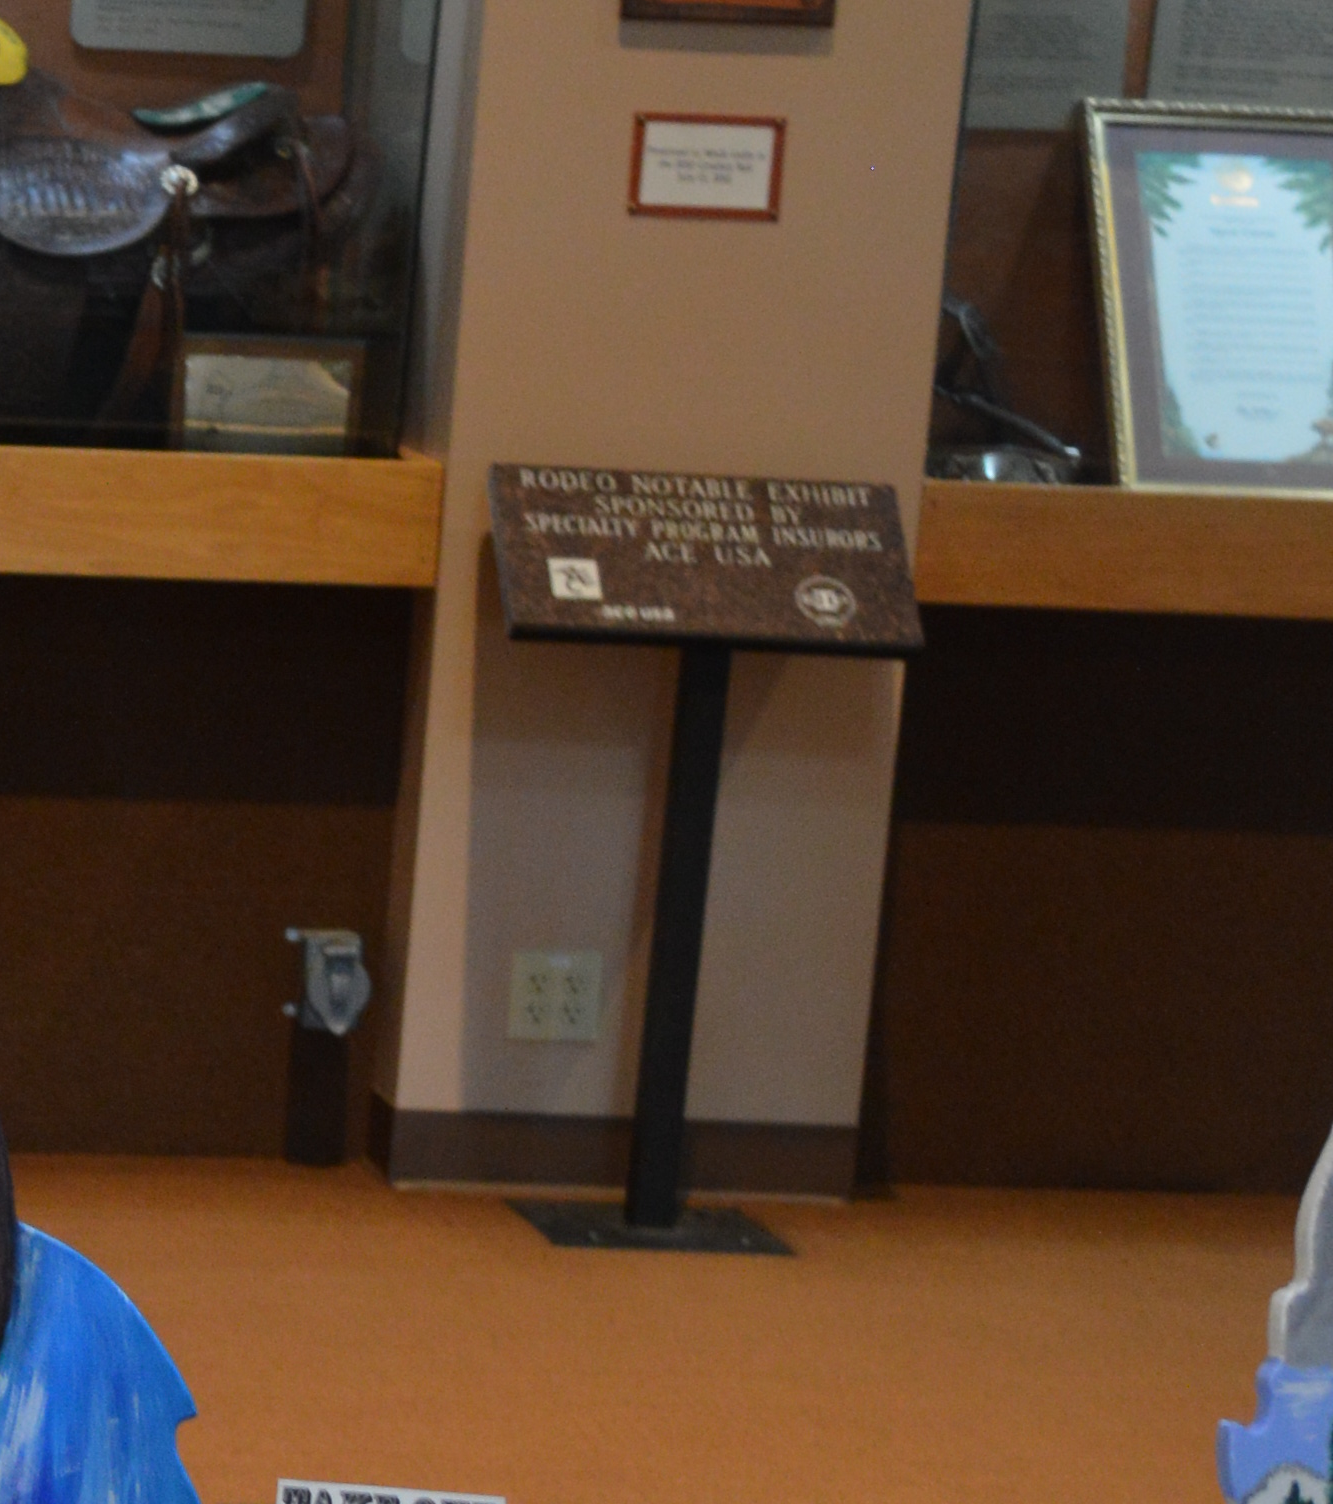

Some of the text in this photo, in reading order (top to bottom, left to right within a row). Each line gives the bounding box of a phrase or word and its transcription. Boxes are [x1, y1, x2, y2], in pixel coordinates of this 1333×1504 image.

[518, 469, 872, 507] RODEO NOTABLE EXHIBIT
[594, 496, 801, 525] SPONSORED BY
[523, 512, 883, 551] SPECIALTY PROGRAM INSURORS
[644, 541, 772, 568] ACE USA
